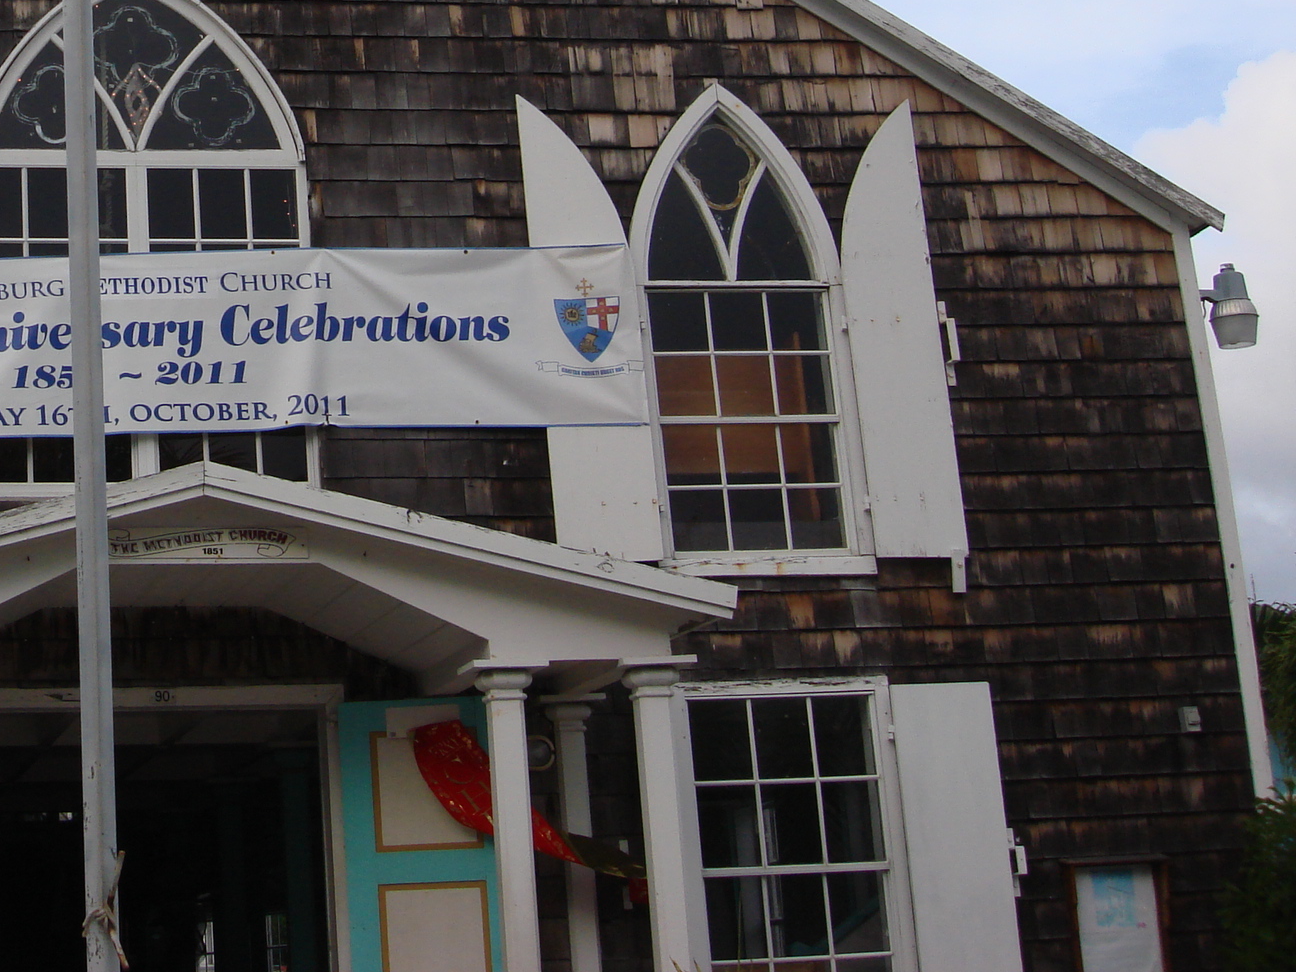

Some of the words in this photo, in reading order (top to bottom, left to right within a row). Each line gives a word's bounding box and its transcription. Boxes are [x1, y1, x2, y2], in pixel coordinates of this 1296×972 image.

[100, 275, 209, 296] ETHODIST
[220, 270, 333, 293] CHURCH
[220, 301, 511, 348] Celebrations
[12, 364, 74, 390] 185
[154, 360, 248, 386] 2011
[129, 400, 277, 424] OCTOBER,
[287, 394, 349, 417] 2011
[228, 529, 289, 544] CHURCH
[201, 547, 224, 555] 1851
